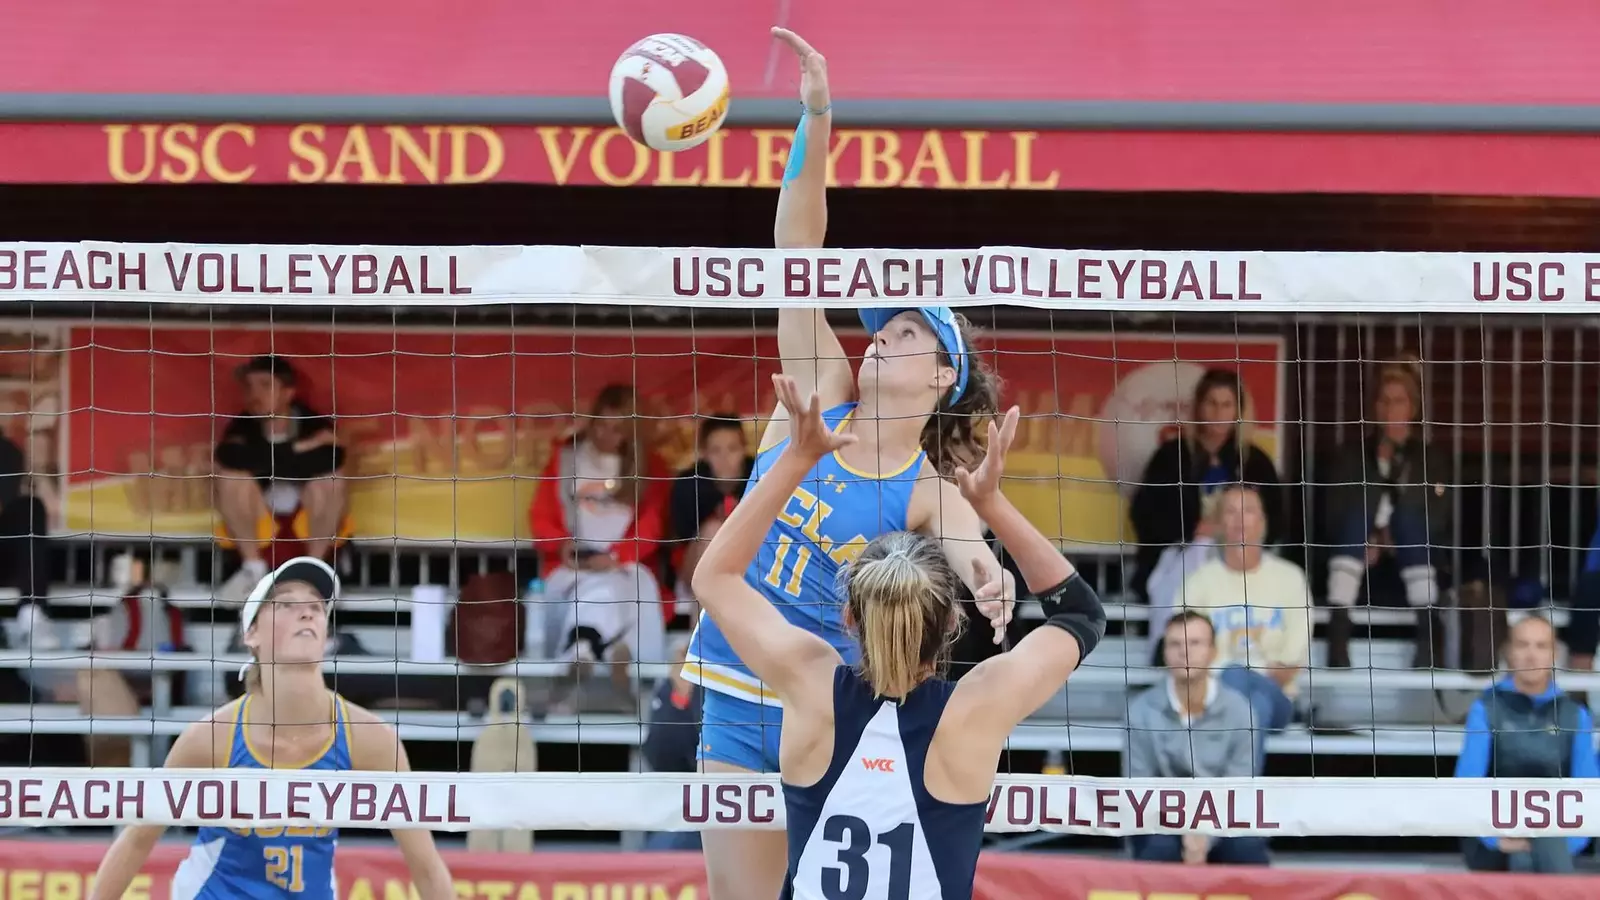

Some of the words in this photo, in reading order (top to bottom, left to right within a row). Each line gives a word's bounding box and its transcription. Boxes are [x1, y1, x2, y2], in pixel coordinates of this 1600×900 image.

[103, 123, 256, 184] USC
[288, 124, 505, 184] SAND
[163, 252, 472, 294] VOLLEYBALL
[673, 256, 764, 298] USC
[784, 258, 944, 298] BEACH
[961, 254, 1262, 300] VOLLEYBALL
[1473, 262, 1565, 301] USC
[765, 533, 812, 597] 11
[861, 757, 896, 773] WCC
[163, 780, 471, 823] VOLLEYBALL
[682, 784, 775, 823] USC
[985, 785, 1280, 829] VOLLEYBALL
[1491, 790, 1583, 829] USC
[263, 845, 305, 893] 21
[821, 815, 915, 900] 31
